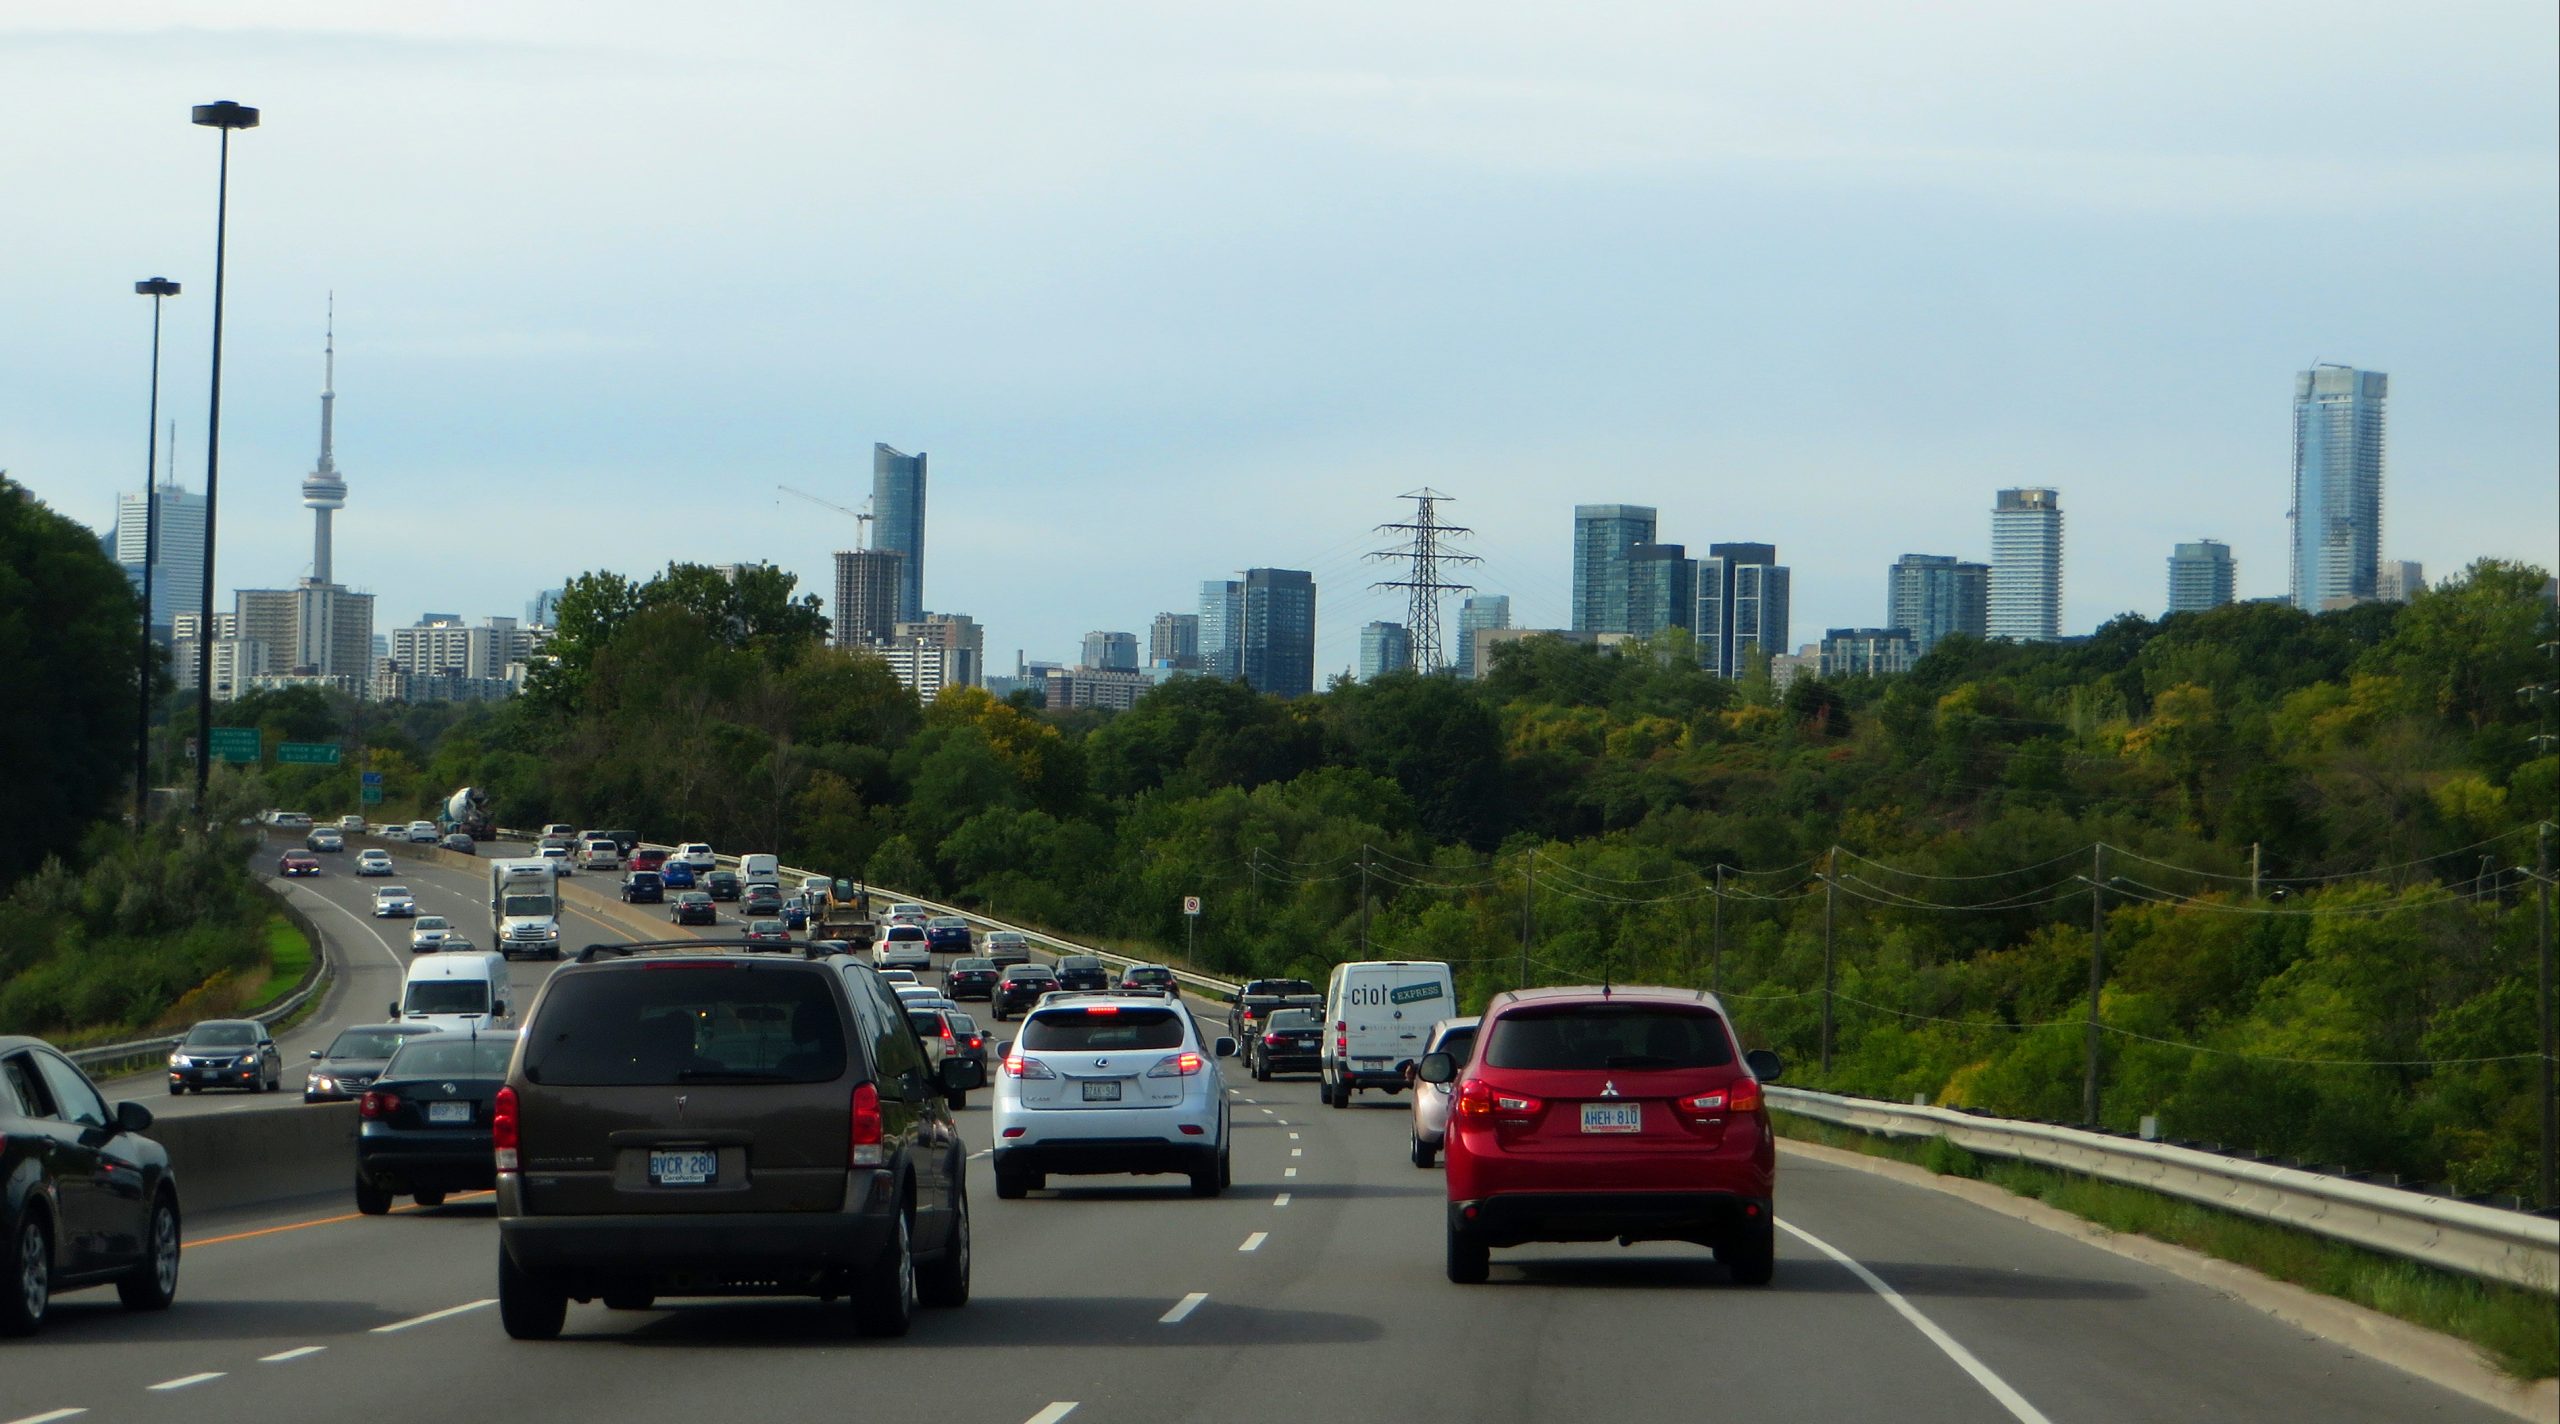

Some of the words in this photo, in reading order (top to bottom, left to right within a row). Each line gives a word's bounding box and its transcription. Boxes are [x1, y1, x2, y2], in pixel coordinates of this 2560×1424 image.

[1352, 984, 1388, 1005] ciot
[1397, 985, 1439, 1000] EXPRESS
[1584, 1110, 1611, 1125] AHEH
[1617, 1110, 1638, 1125] 810
[650, 1156, 683, 1174] BVCR
[690, 1155, 715, 1173] 280
